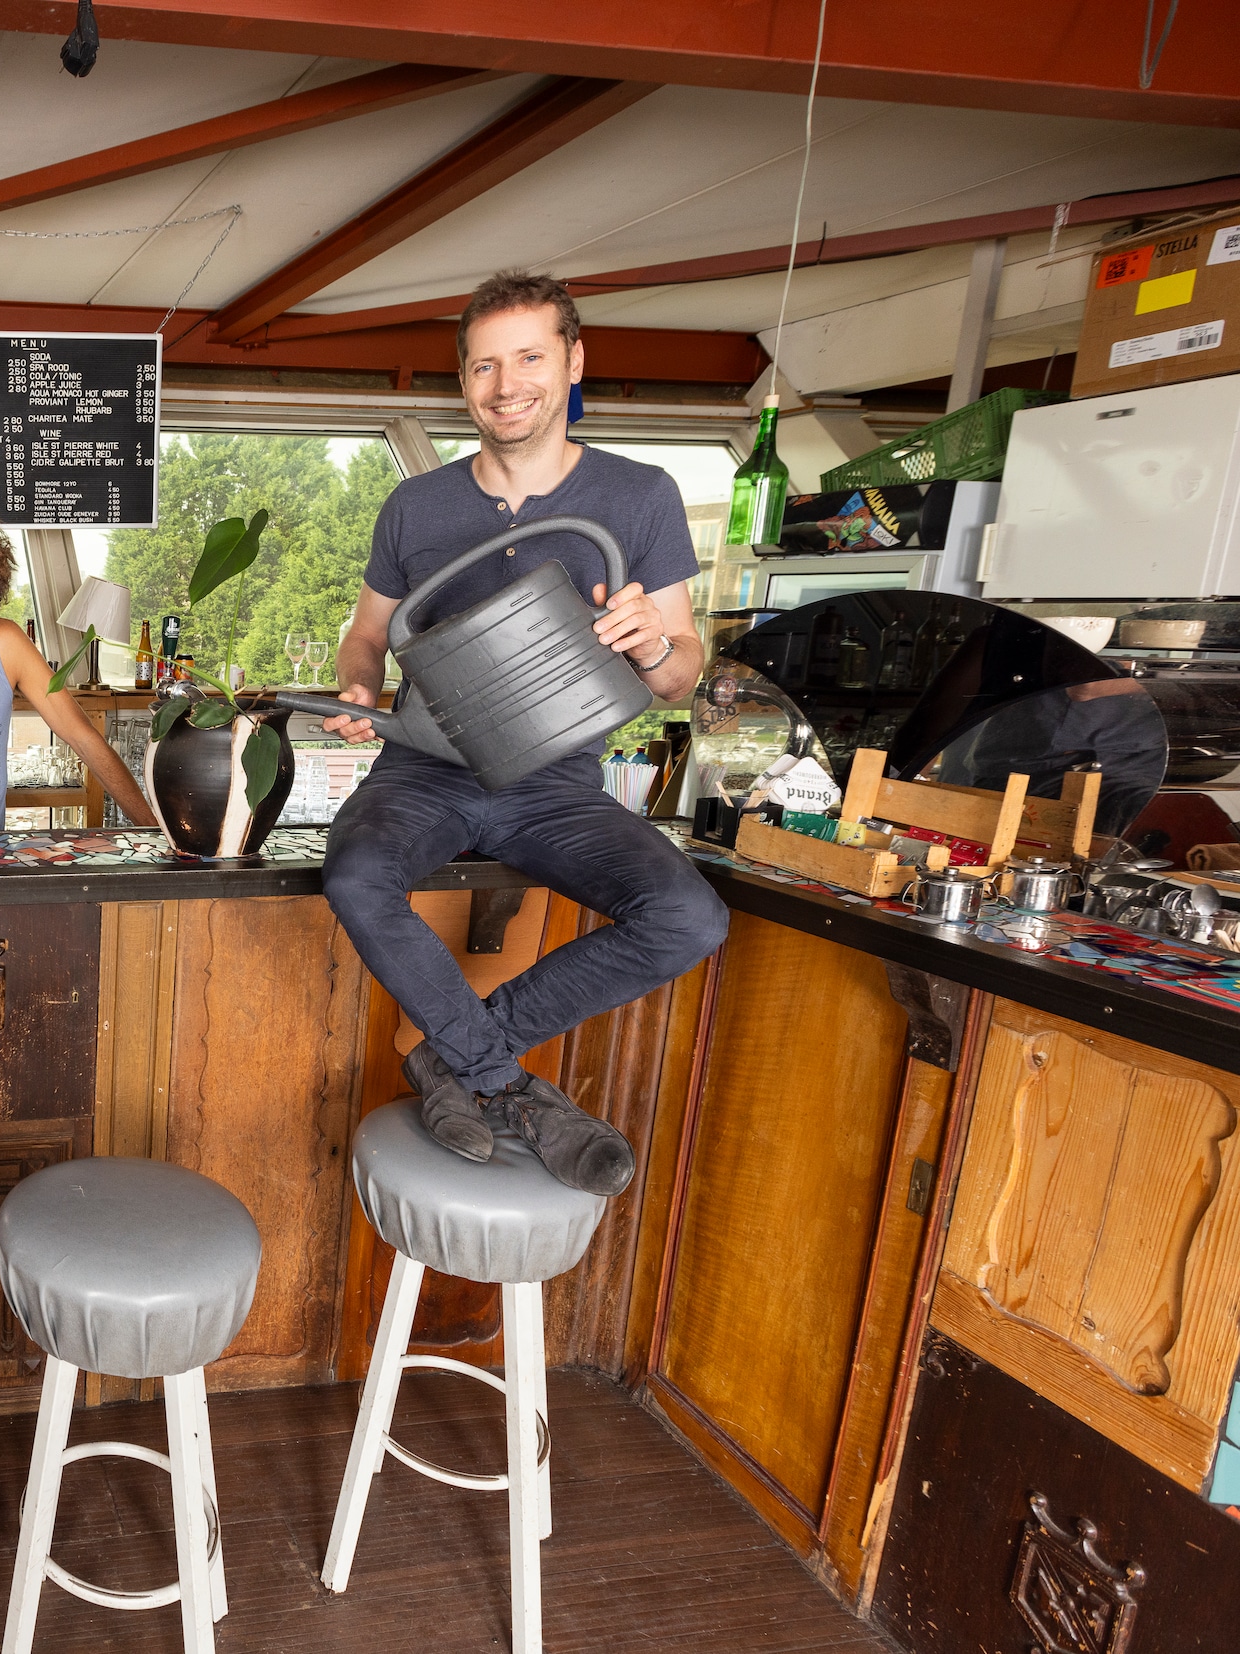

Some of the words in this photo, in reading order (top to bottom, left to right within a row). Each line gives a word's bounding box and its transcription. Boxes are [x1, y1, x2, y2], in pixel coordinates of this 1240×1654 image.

[1157, 235, 1198, 258] STELLA
[11, 339, 47, 347] MENU
[30, 353, 51, 361] SODA
[30, 364, 45, 372] SPA
[48, 364, 69, 372] ROOD
[136, 364, 156, 374] 2,50
[136, 373, 156, 382] 2,80
[30, 381, 56, 389] APPLE
[59, 381, 81, 389] JUICE
[136, 381, 142, 389] 3
[29, 389, 50, 397] AQUA
[52, 389, 82, 397] MONACO
[85, 389, 99, 397] HOT
[102, 389, 129, 397] GINGER
[29, 398, 69, 406] PROVIANT
[75, 398, 103, 406] LEMON
[28, 415, 67, 423] CHARITEA
[73, 415, 93, 423] MATE
[5, 435, 11, 443] 4
[31, 442, 48, 450] ISLE
[51, 442, 60, 450] ST
[64, 442, 93, 450] PIERRE
[96, 442, 119, 450] WHITE
[136, 442, 142, 450] 4
[31, 450, 48, 458] ISLE
[51, 450, 60, 458] ST
[64, 450, 93, 458] PIERRE
[95, 450, 111, 458] RED
[136, 450, 142, 458] 4
[7, 487, 13, 495] 5
[874, 528, 894, 545] LOKI
[787, 787, 832, 806] Brand
